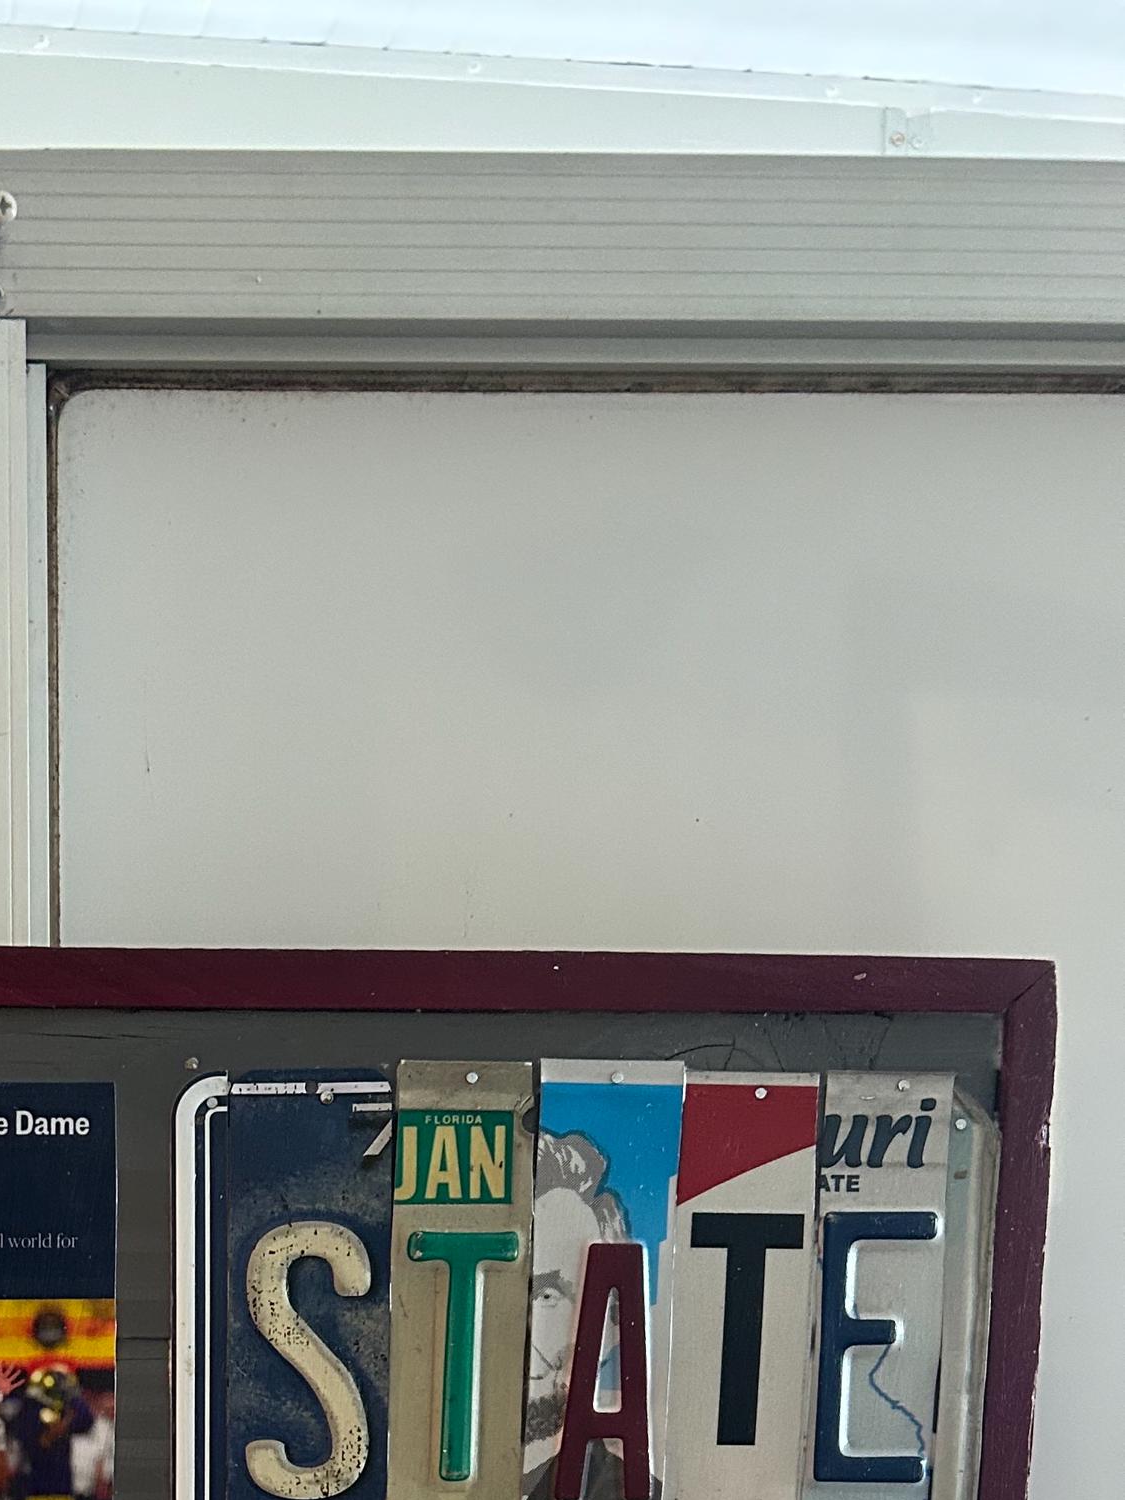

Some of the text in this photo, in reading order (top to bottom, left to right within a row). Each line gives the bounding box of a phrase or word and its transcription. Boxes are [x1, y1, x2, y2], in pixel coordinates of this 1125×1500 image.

[15, 1112, 91, 1136] Dame
[425, 1114, 483, 1125] FLORIDA
[394, 1125, 506, 1201] JAN
[8, 1233, 53, 1250] world
[56, 1233, 79, 1249] for
[245, 1211, 942, 1500] STATE
